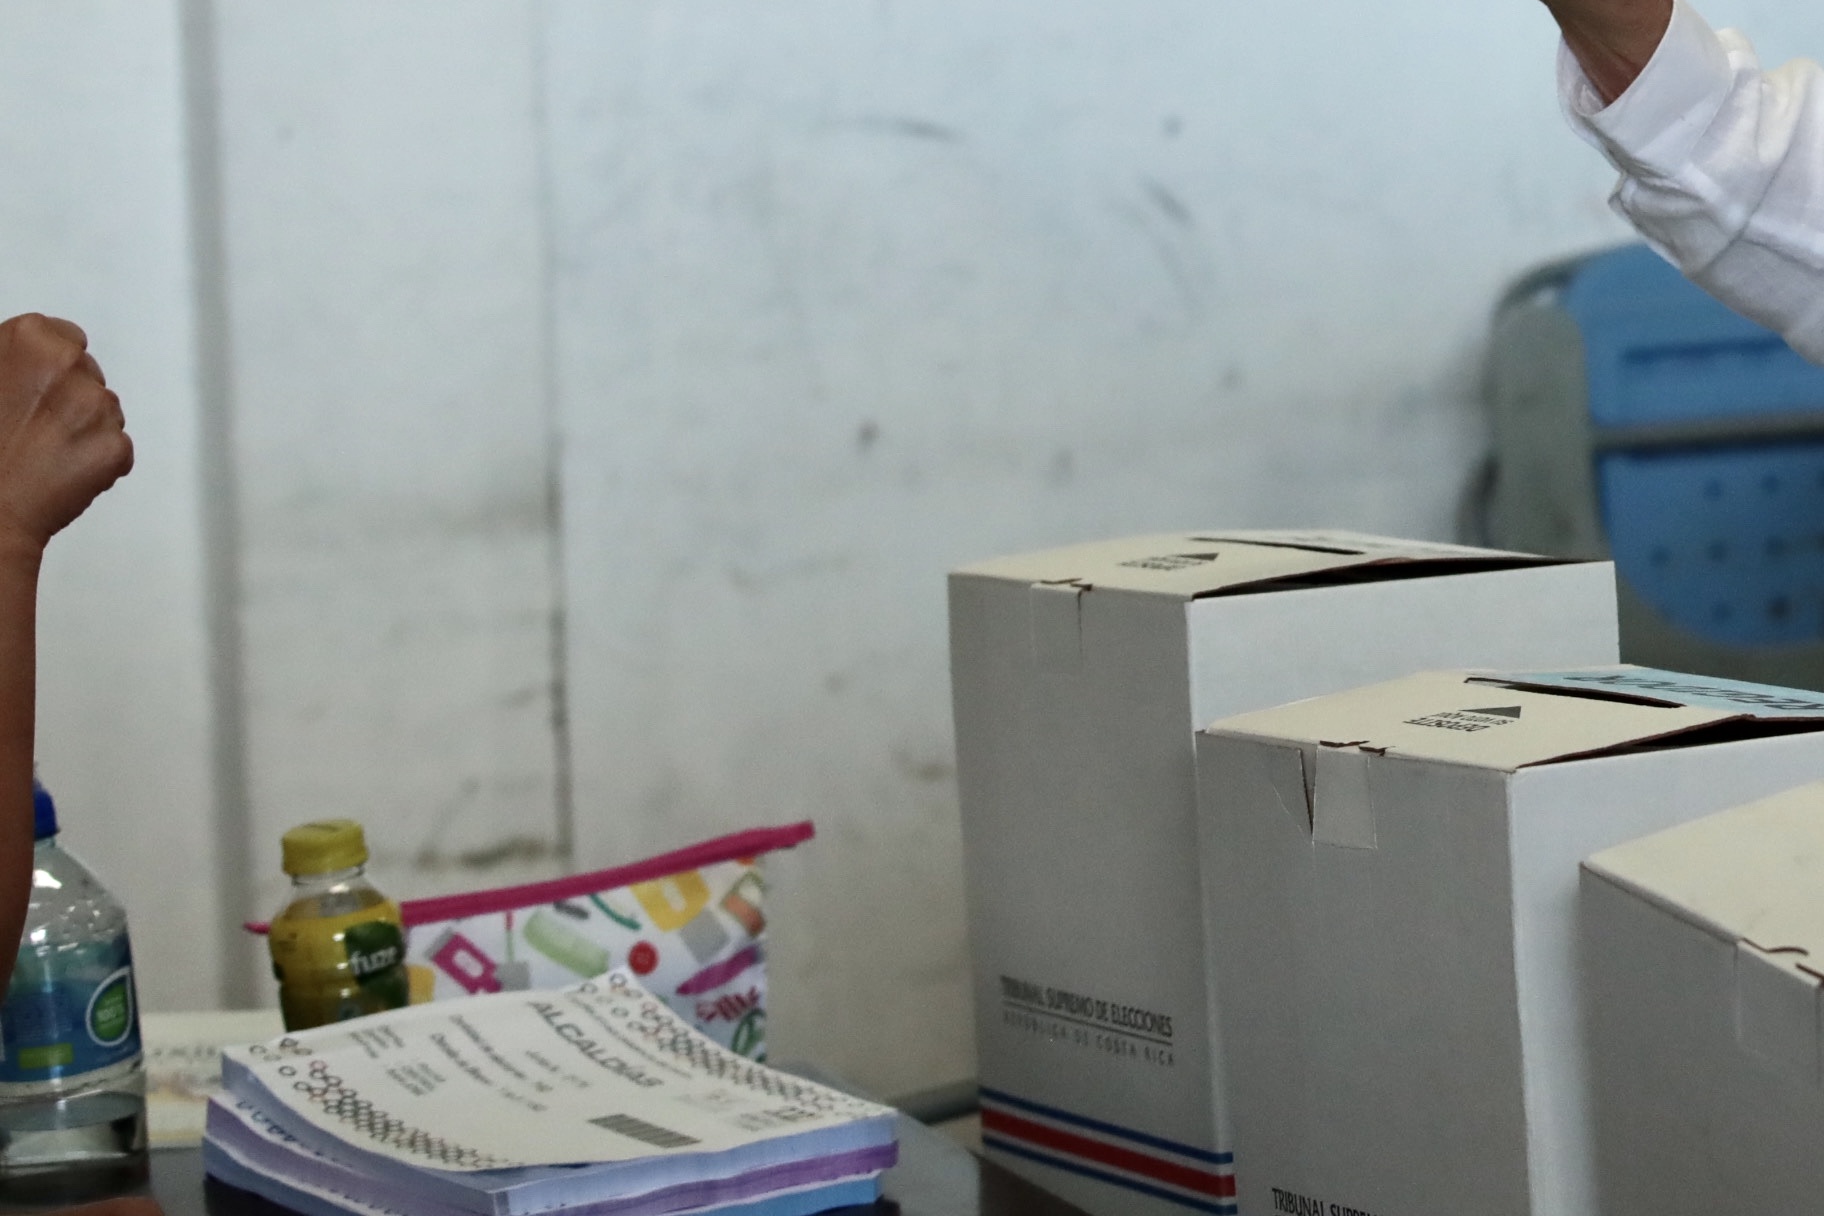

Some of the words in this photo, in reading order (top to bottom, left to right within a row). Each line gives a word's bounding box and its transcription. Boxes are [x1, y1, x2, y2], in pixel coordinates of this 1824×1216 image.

[1096, 999, 1109, 1022] DE
[1110, 1003, 1173, 1038] ELECCIONES
[1272, 1187, 1325, 1216] TRIBUNAL
